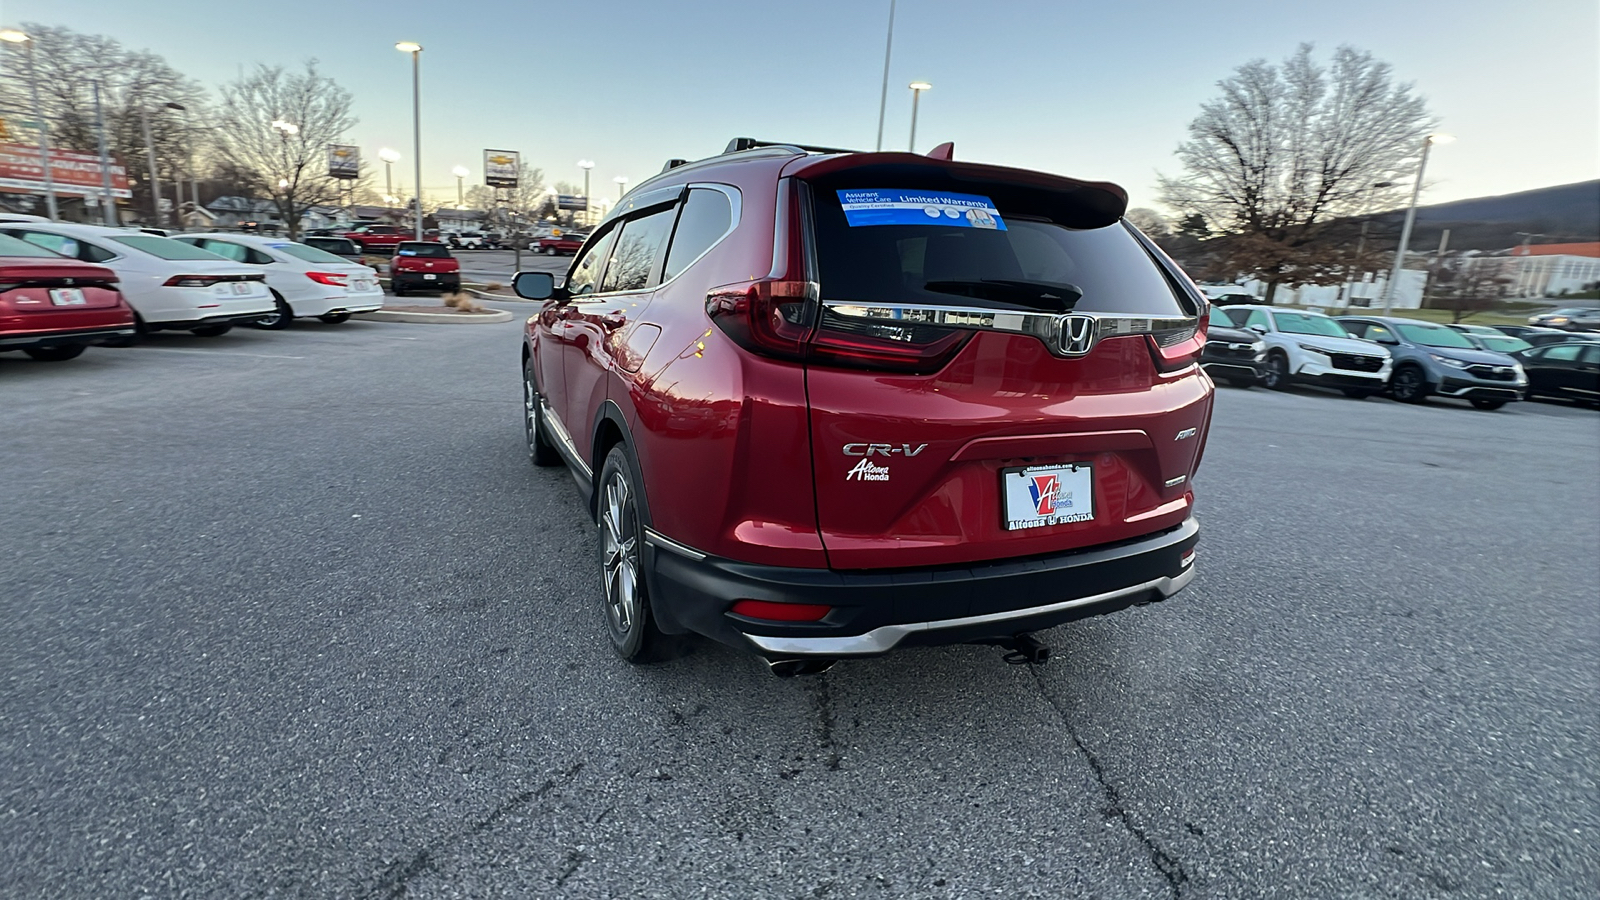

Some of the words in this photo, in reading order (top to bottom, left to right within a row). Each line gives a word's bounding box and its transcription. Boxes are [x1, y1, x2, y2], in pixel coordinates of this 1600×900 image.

[900, 195, 940, 204] Limited
[940, 197, 988, 209] Warranty
[842, 443, 929, 457] CR-V
[846, 457, 889, 481] Altoona
[864, 473, 890, 481] Honda
[1008, 519, 1046, 531] Altoona
[1059, 513, 1095, 524] HONDA
